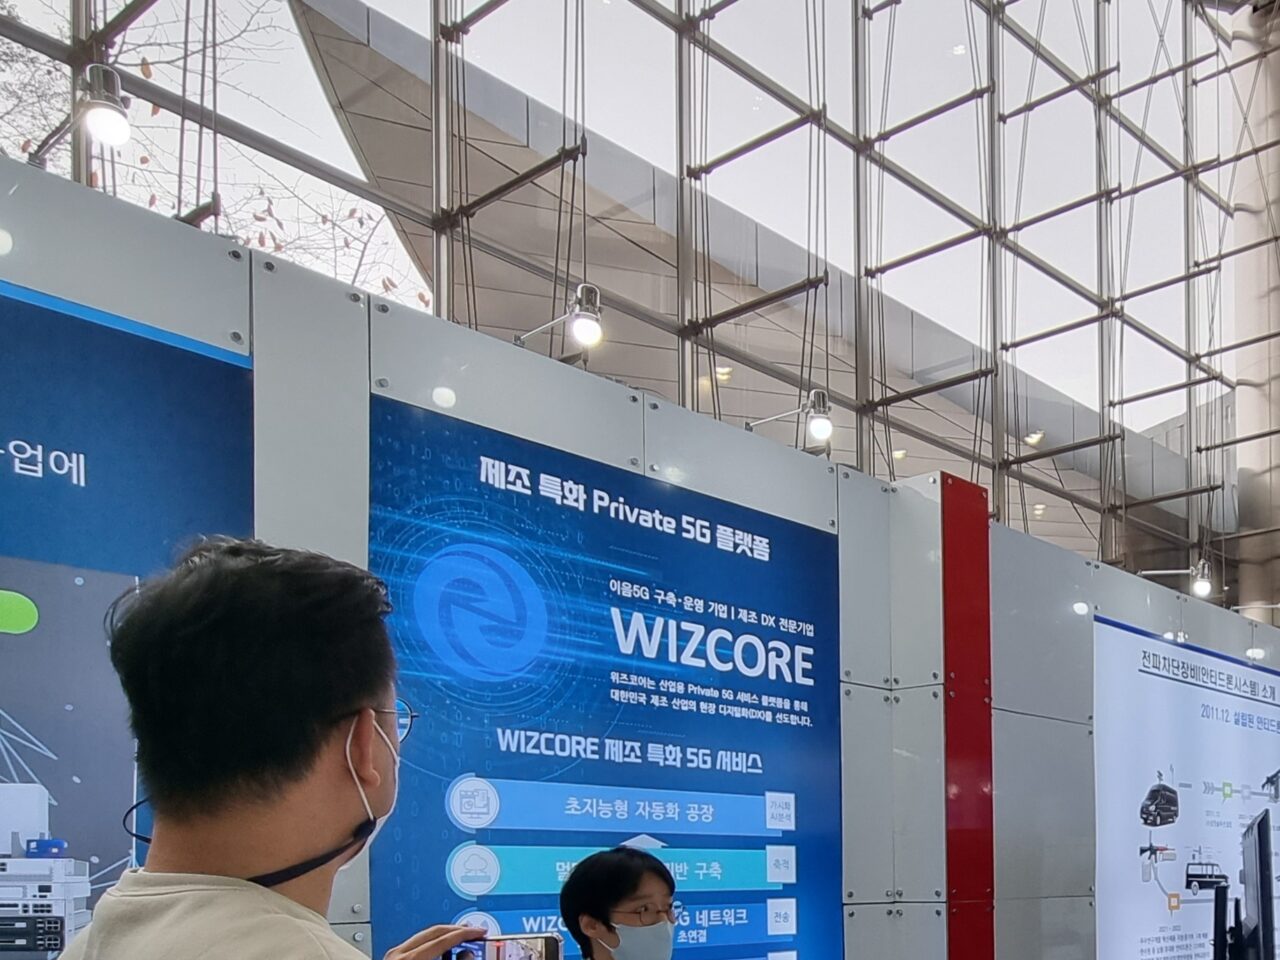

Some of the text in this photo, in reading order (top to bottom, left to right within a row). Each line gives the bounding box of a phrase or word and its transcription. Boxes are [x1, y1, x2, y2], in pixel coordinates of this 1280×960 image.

[0, 439, 86, 487] 업에
[480, 456, 770, 562] 제조 특화 Private 5G 플랫폼
[609, 579, 650, 600] 이음5G
[708, 601, 728, 619] 기업
[737, 608, 758, 624] 제조
[761, 614, 776, 628] DX
[779, 618, 815, 637] 전문기업
[610, 607, 815, 686] WIZCORE
[610, 689, 647, 706] 대한민국
[650, 695, 669, 708] 제조
[688, 684, 719, 699] Private
[722, 689, 734, 701] 5G
[1262, 685, 1277, 702] 소개
[497, 728, 763, 774] WIZCORE 제조 특화 5G 서비스
[564, 797, 715, 824] 초지능형 자동화 공장
[694, 861, 723, 881] 구축
[695, 909, 749, 927] 네트워크
[677, 929, 707, 944] 초연결
